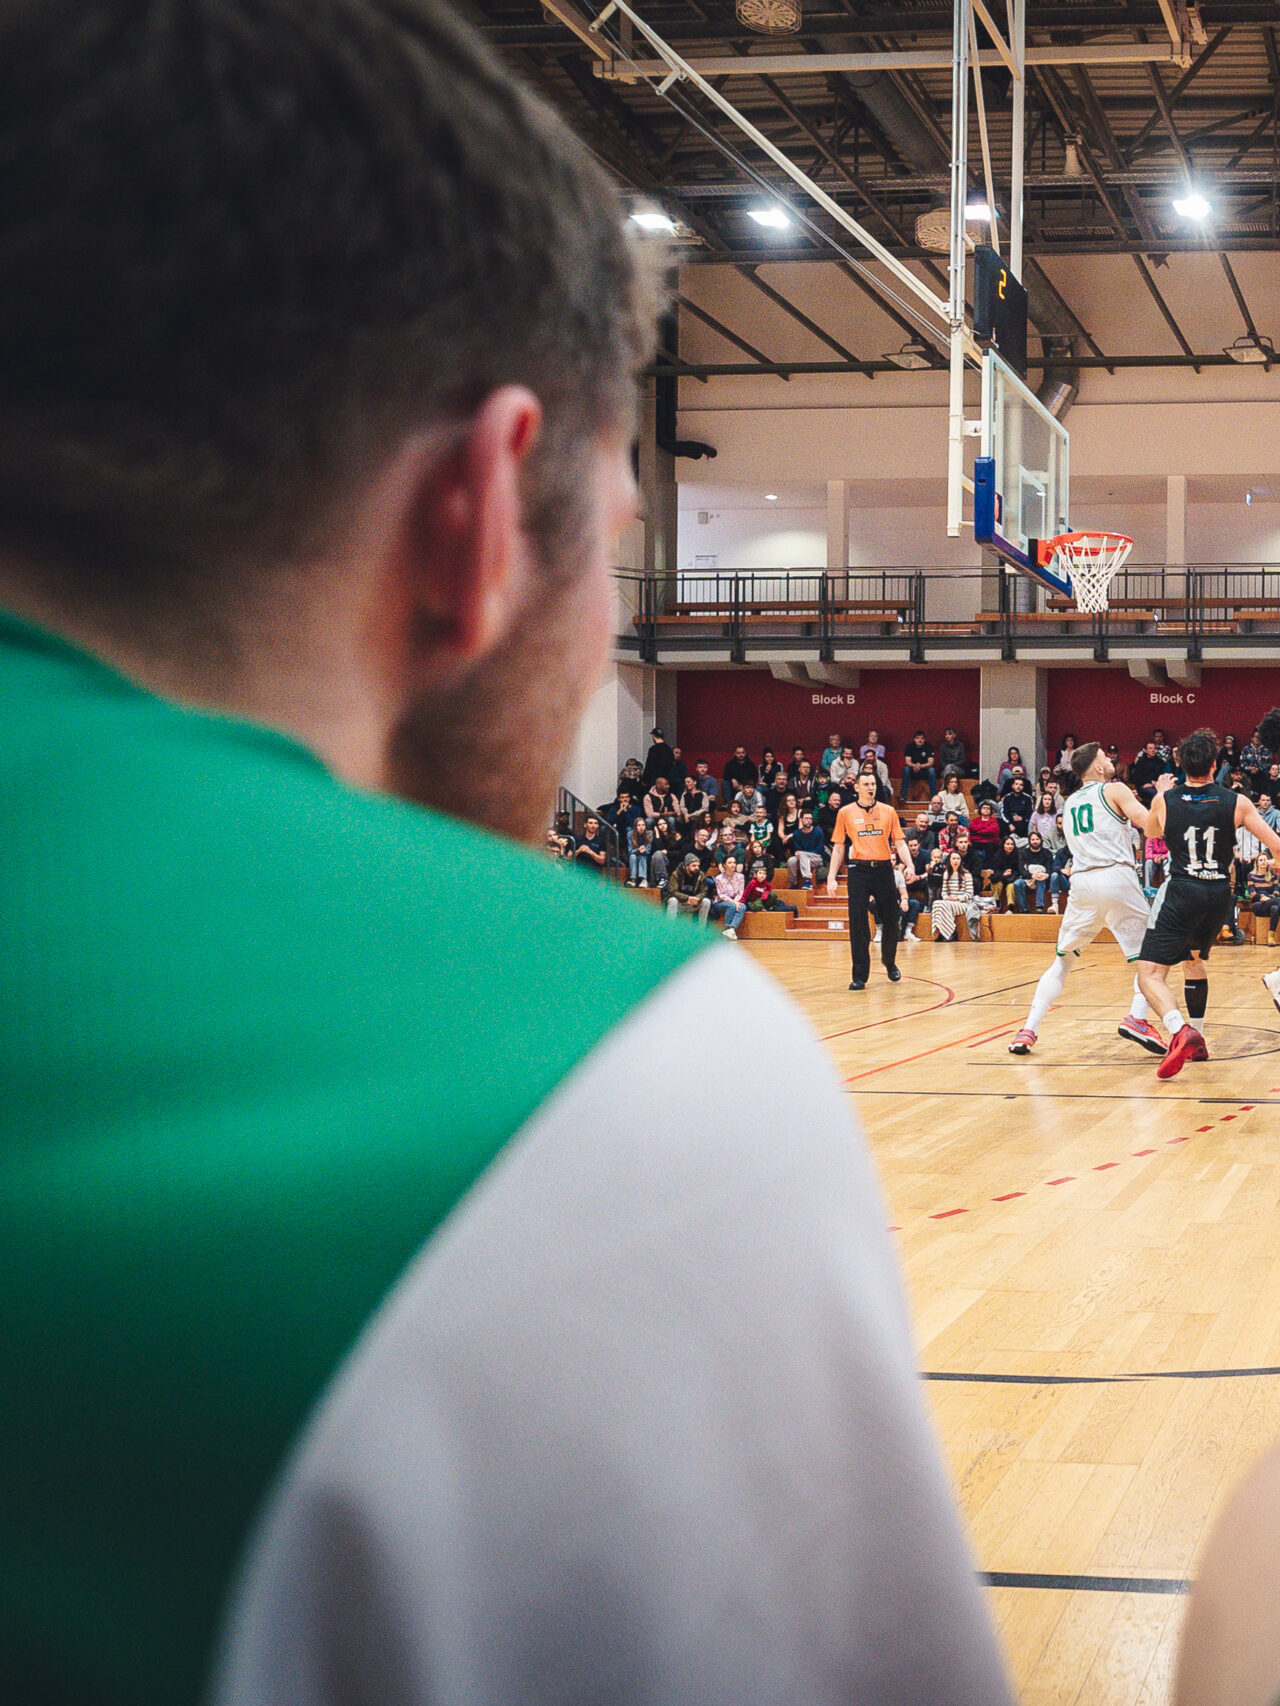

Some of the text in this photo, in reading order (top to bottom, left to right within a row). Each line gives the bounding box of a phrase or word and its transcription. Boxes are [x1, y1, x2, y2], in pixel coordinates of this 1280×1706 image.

[999, 268, 1007, 300] 2
[812, 694, 856, 705] Block B
[1150, 693, 1196, 704] Block C
[1071, 803, 1094, 836] 10
[1183, 825, 1219, 870] 11
